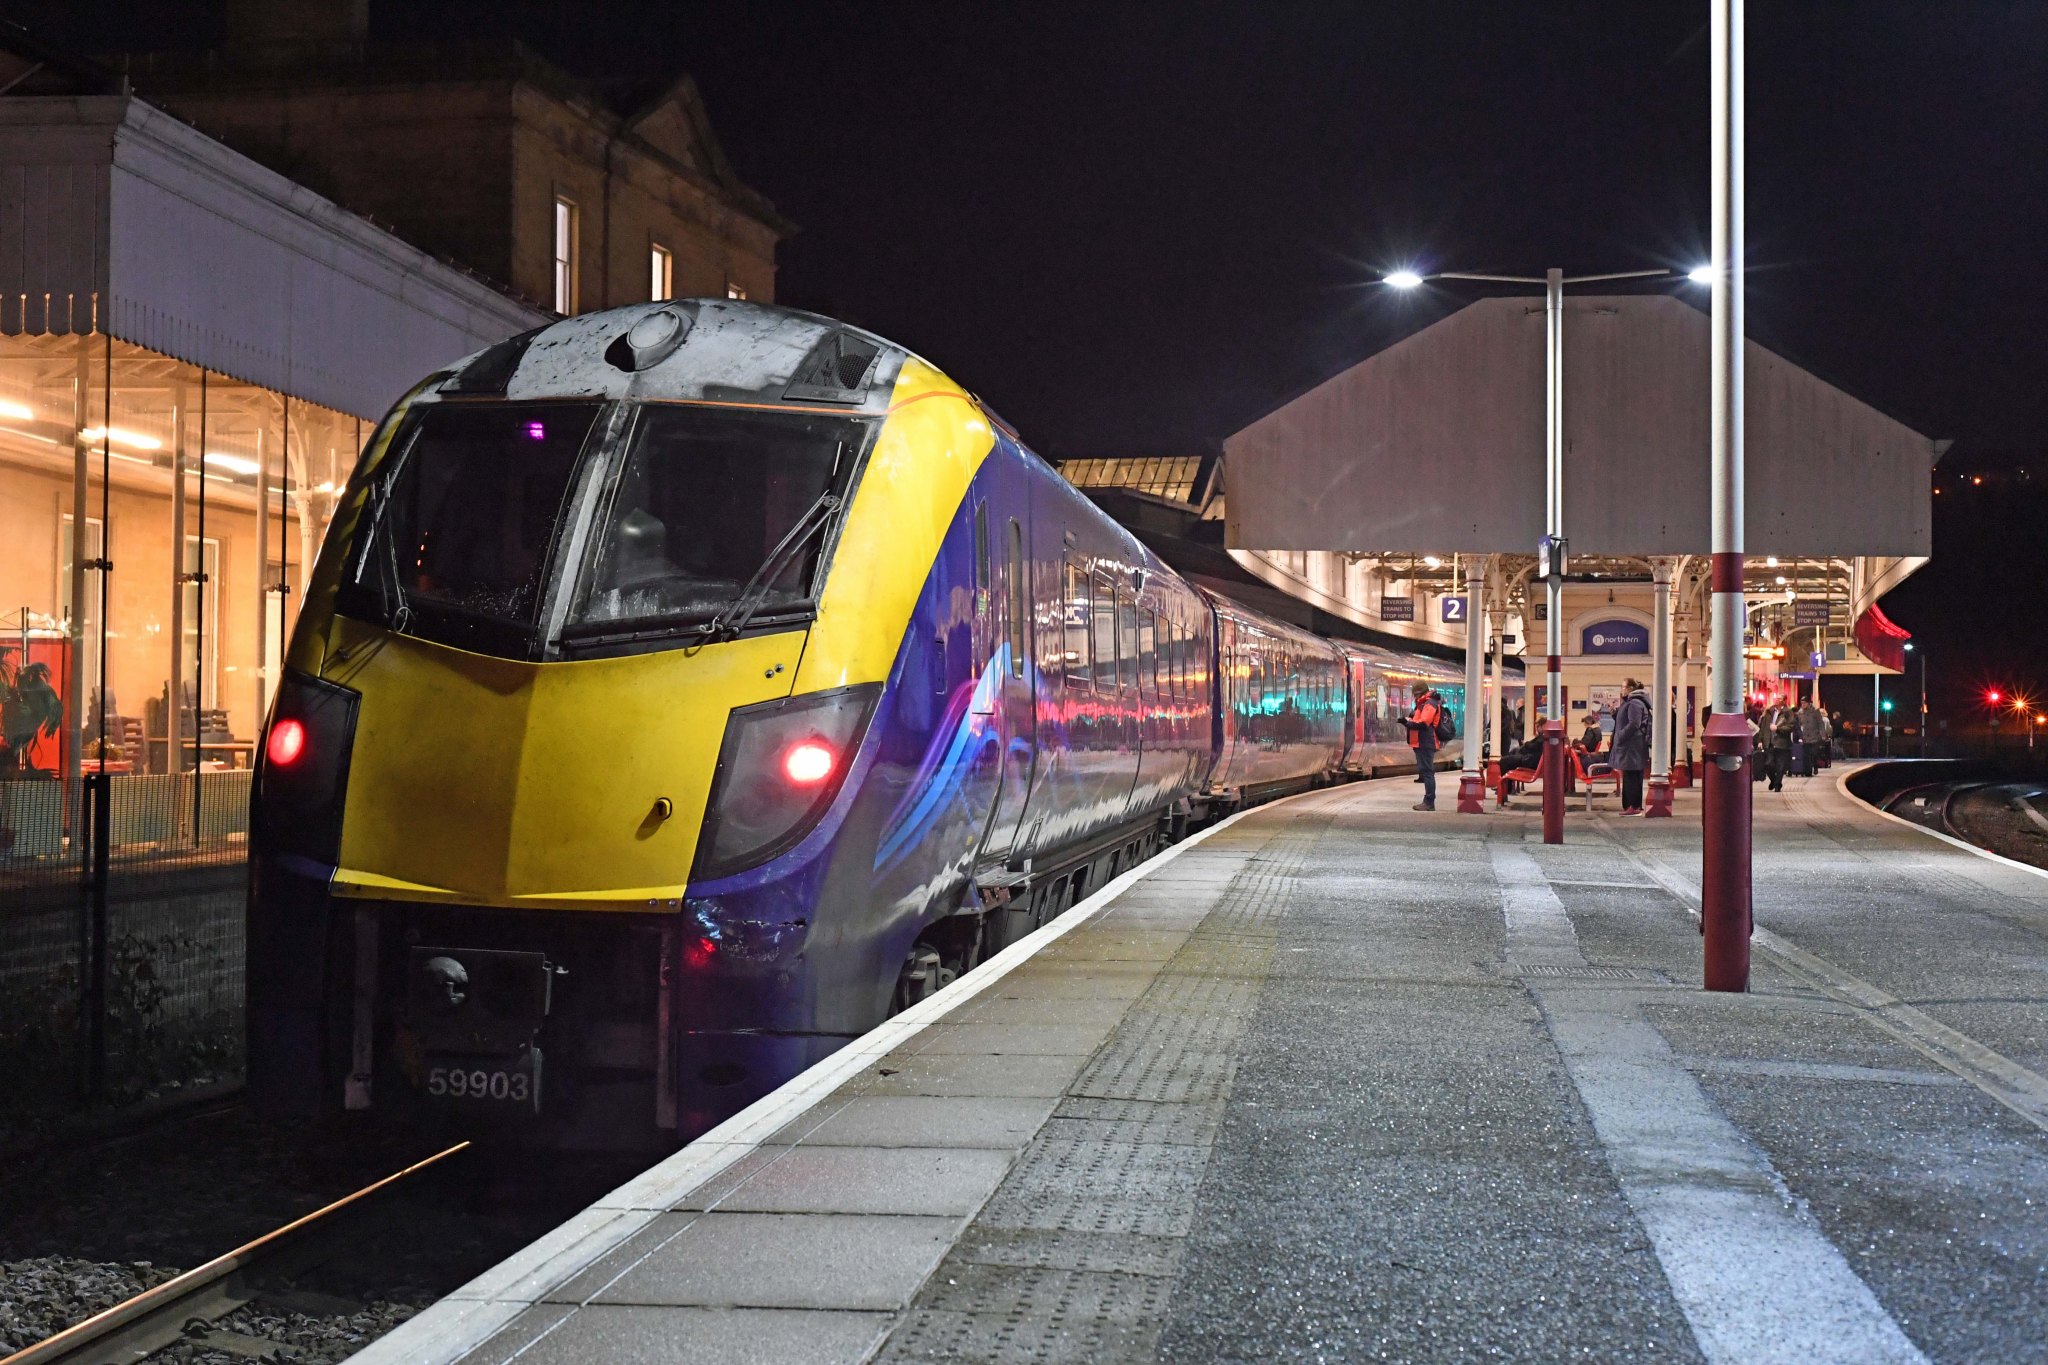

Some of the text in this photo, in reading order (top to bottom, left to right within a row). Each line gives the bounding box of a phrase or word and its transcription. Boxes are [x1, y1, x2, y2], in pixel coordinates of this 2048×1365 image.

[1447, 600, 1460, 619] 2
[1815, 654, 1822, 666] 1
[428, 1068, 529, 1101] 59903
